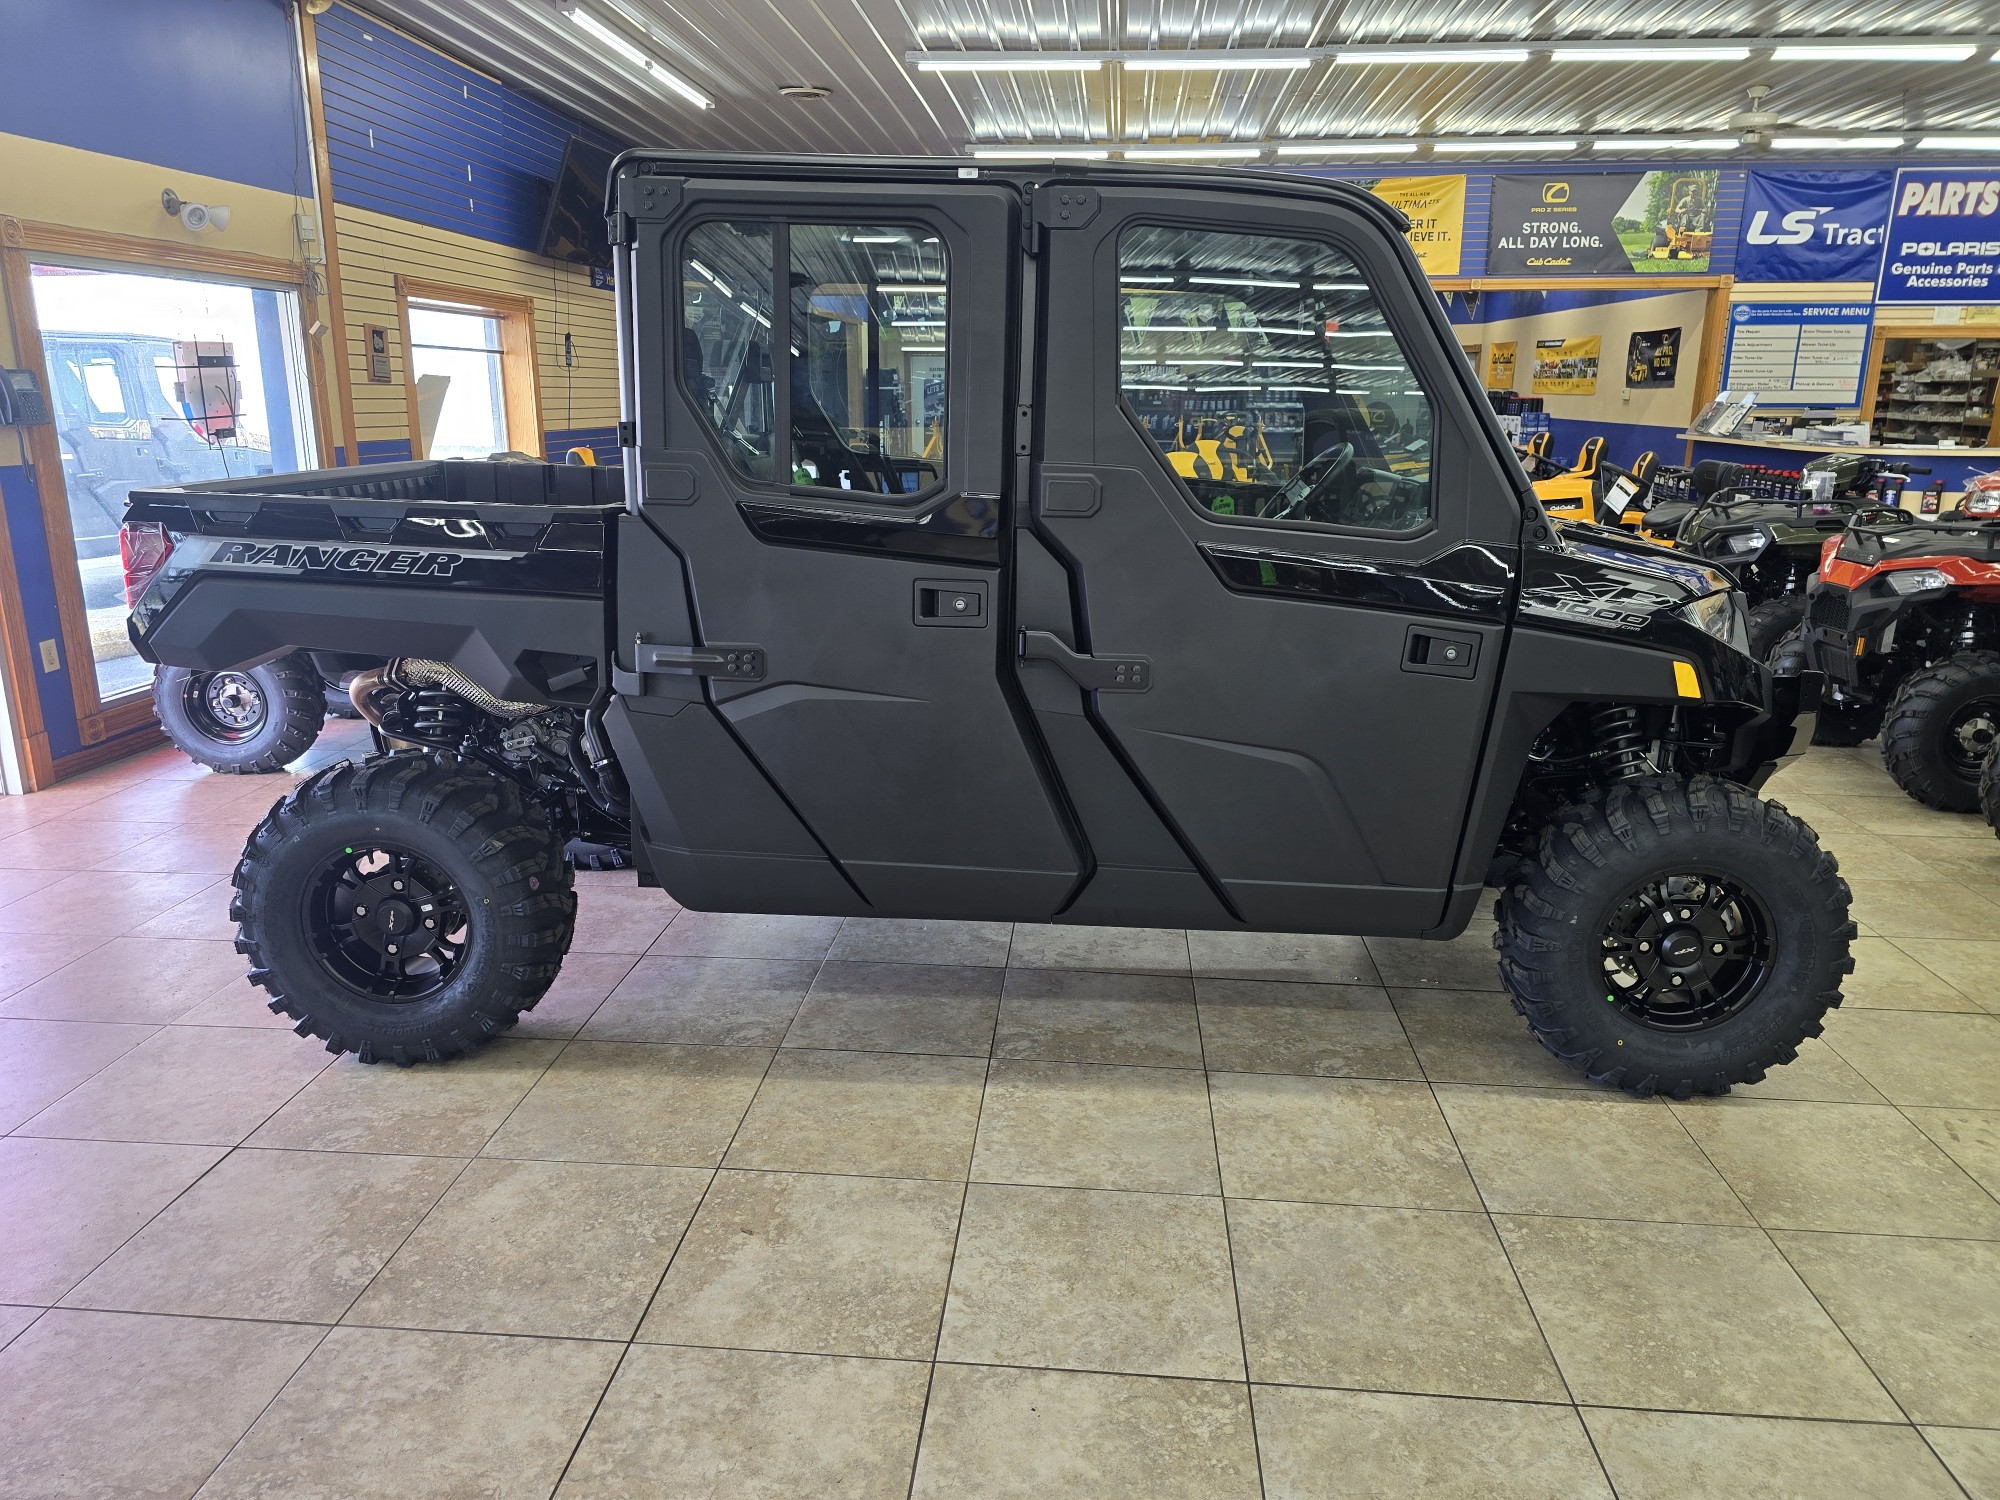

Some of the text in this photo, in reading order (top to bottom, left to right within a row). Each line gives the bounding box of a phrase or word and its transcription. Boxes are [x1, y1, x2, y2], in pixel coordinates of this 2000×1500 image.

[1391, 200, 1427, 210] ULTIMA
[1898, 181, 2000, 216] PARTS
[1426, 219, 1437, 229] IT
[1522, 222, 1582, 234] STRONG.
[1746, 210, 1817, 245] LS
[1437, 231, 1451, 242] IT.
[1498, 235, 1603, 249] ALL DAY LONG.
[1901, 241, 2000, 256] POLARIS
[1526, 257, 1572, 266] Cub Cadet
[1891, 262, 1953, 275] Genuine
[1956, 262, 1993, 275] Parts
[1906, 275, 1988, 288] Accessories
[1802, 307, 1839, 316] SERVICE
[1841, 307, 1870, 316] MENU
[208, 541, 464, 577] RANGER
[1555, 600, 1652, 628] 1000
[1621, 624, 1641, 632] CAM
